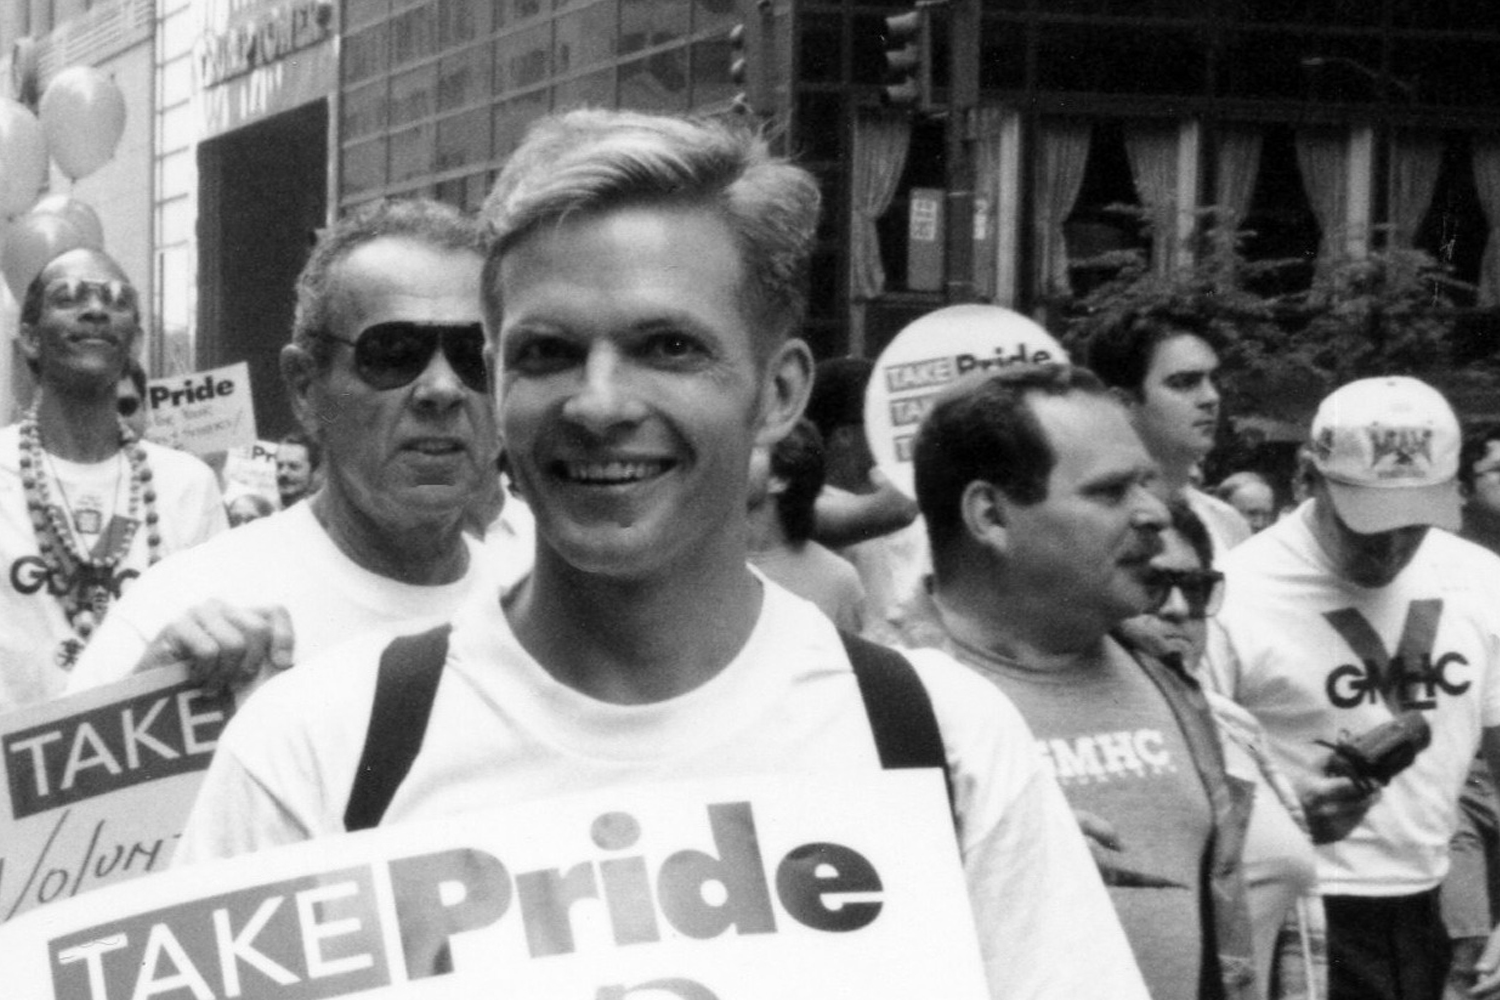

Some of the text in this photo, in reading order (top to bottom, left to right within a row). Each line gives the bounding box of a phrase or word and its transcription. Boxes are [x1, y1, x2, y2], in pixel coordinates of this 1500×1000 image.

[150, 375, 235, 410] Pride
[1325, 652, 1472, 712] GMHC
[9, 689, 228, 798] TAKE
[388, 801, 885, 981] Pride
